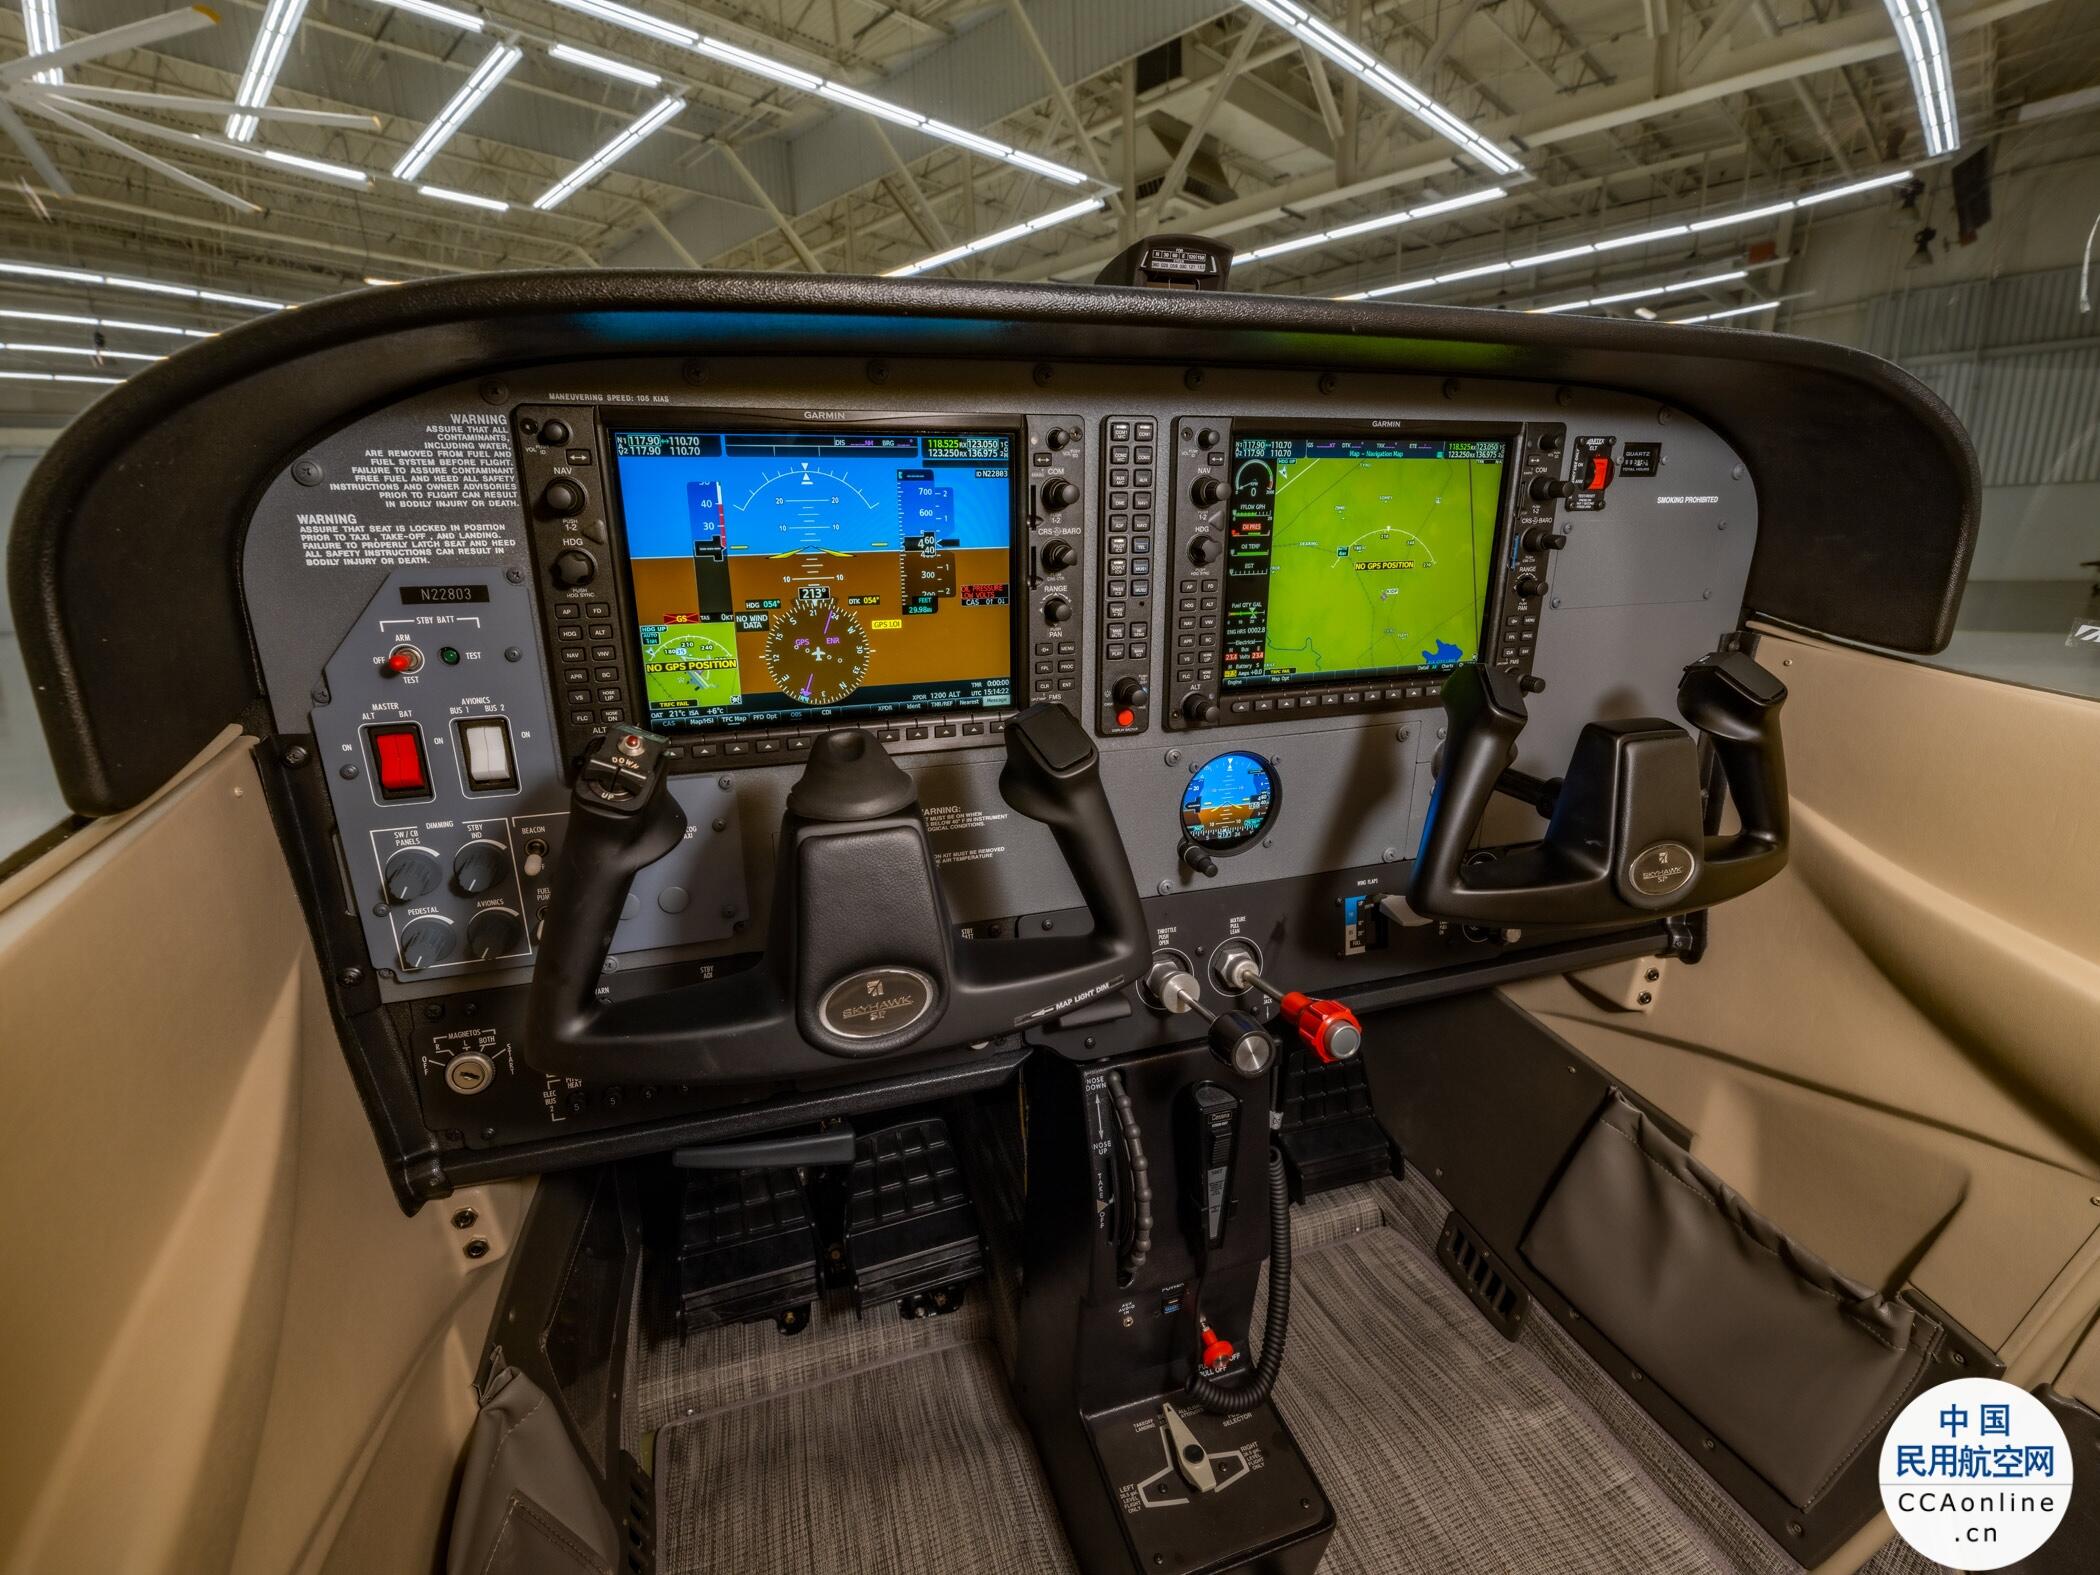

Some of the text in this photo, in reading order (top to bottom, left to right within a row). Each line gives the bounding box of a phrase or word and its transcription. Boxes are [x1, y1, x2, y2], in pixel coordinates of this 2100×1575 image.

[549, 393, 603, 401] MANEUVERING
[450, 414, 507, 425] WARNING
[804, 411, 845, 420] GARMIN
[438, 434, 510, 442] CONTAMINANTS,
[630, 436, 699, 445] 117.90 110.70
[928, 440, 998, 448] 118.525 123.050
[631, 447, 700, 455] 117.90 110.70
[968, 450, 998, 458] 136.975
[701, 500, 712, 508] 40
[1657, 496, 1684, 504] SMOKING
[920, 509, 933, 517] 600
[297, 514, 357, 525] WARNING
[300, 525, 338, 533] ASSURE
[409, 524, 447, 532] LOCKED
[703, 522, 714, 530] 30
[362, 541, 408, 549] PROPERLY
[412, 540, 440, 548] LATCH
[563, 538, 583, 546] HDG
[305, 550, 322, 558] ALL
[326, 549, 361, 557] SAFETY
[365, 548, 432, 557] INSTRUCTIONS
[307, 558, 339, 566] BODILY
[399, 556, 430, 564] DEATH.
[1383, 561, 1414, 569] POSITION
[421, 588, 471, 601] N22803
[803, 588, 826, 598] 213°
[417, 616, 454, 625] STBY BATT
[466, 652, 481, 660] TEST
[647, 660, 736, 672] NO GPS POSITION
[404, 676, 419, 684] TEST
[987, 679, 1009, 687] 0:00:00
[462, 697, 490, 705] AVIONICS
[372, 703, 399, 711] MASTER
[399, 710, 412, 718] BAT
[434, 737, 443, 745] ON
[342, 744, 352, 752] ON
[612, 757, 639, 769] DOWN
[602, 792, 614, 800] UP
[426, 821, 453, 829] DIMMING
[467, 824, 483, 832] STBY
[522, 826, 545, 834] BEACON
[396, 838, 420, 846] PANELS
[477, 899, 504, 908] AVIONICS
[408, 906, 439, 916] PEDESTAL
[1056, 983, 1109, 1010] MAP LIGHT DIM
[842, 995, 912, 1019] SKYHAWK
[448, 1029, 480, 1039] MAGNETOS
[479, 1036, 495, 1044] BOTH
[1087, 1076, 1105, 1085] NOSE
[1086, 1083, 1106, 1092] DOWN
[1094, 1140, 1111, 1150] NOSE
[1241, 1442, 1258, 1452] RIGHT
[1120, 1484, 1135, 1493] LEFT
